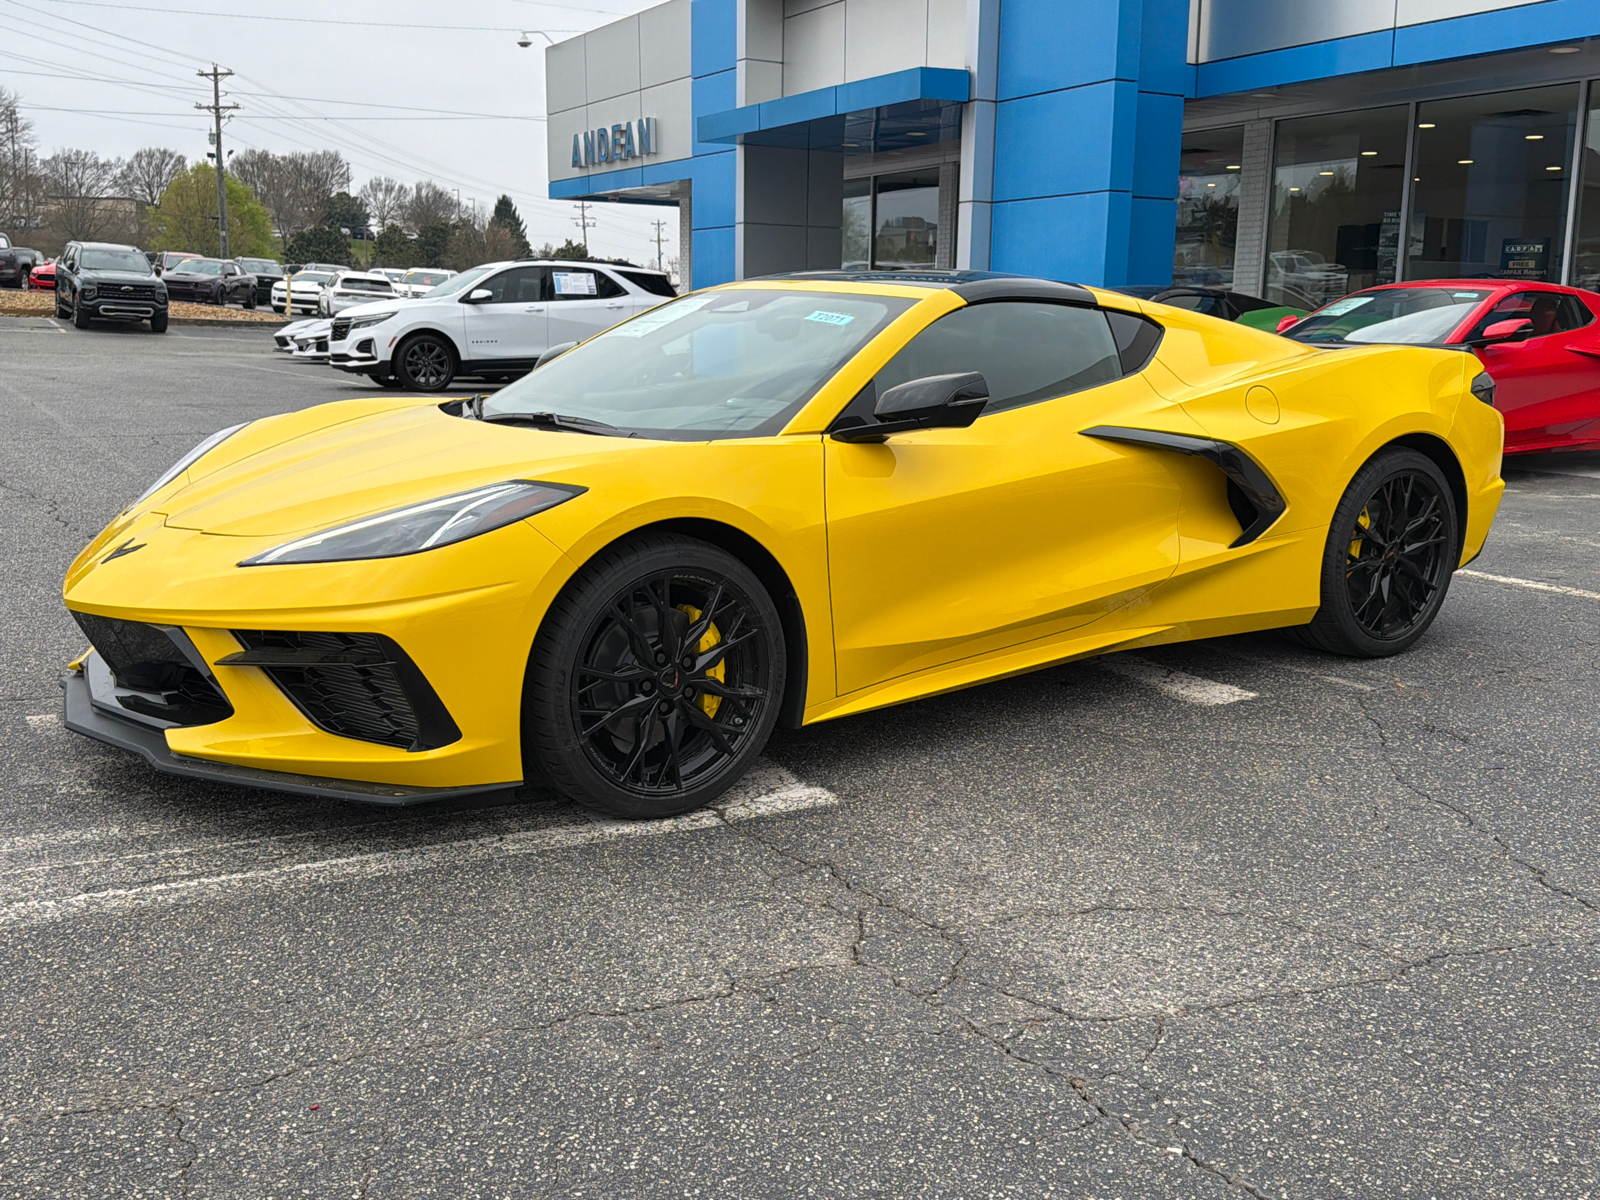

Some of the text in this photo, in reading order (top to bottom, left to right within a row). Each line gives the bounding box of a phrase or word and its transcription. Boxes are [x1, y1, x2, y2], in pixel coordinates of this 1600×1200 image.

[571, 117, 657, 168] ANDEAN
[1505, 245, 1543, 253] CARFAX
[813, 312, 846, 324] T2071
[672, 574, 717, 586] CORVETTE
[589, 747, 615, 775] FORGED
